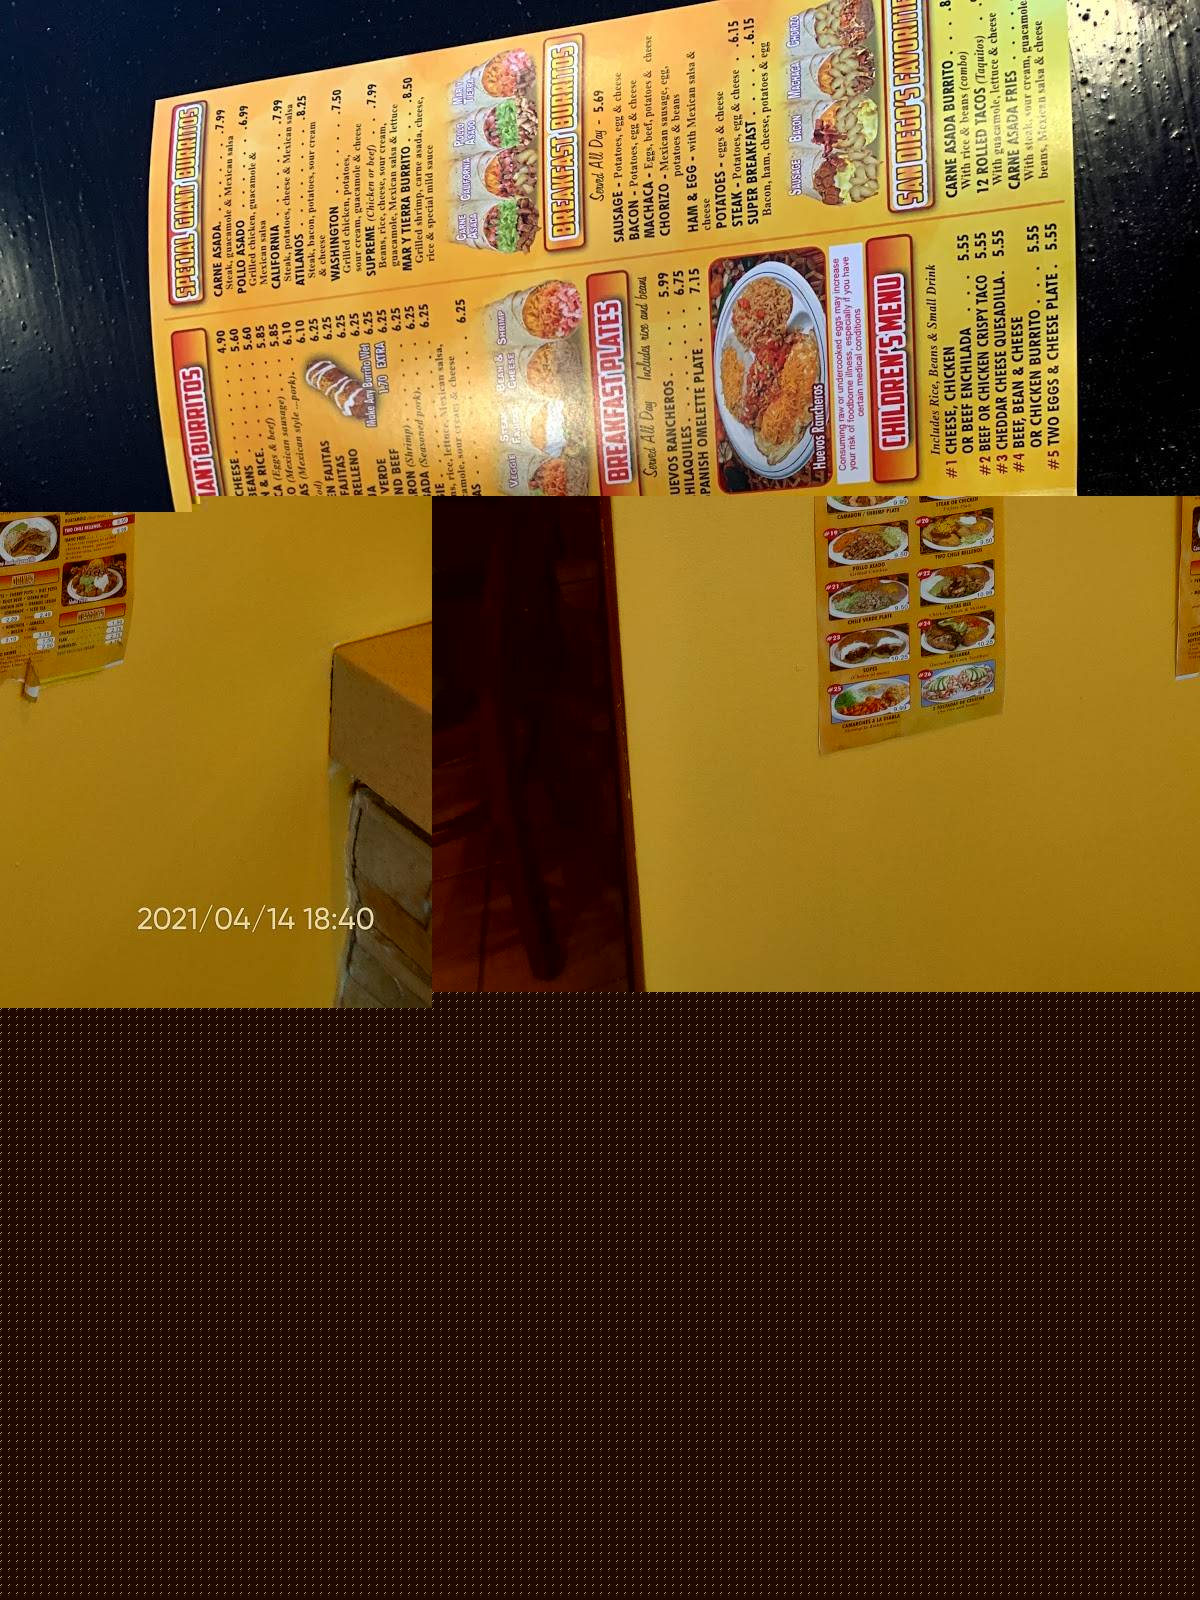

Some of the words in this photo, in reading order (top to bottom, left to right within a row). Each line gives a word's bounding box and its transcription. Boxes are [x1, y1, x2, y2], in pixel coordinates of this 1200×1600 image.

[549, 46, 575, 131] BURRITOS
[593, 90, 604, 113] 5.69
[942, 60, 955, 111] BURRITO
[974, 87, 987, 125] TACOS
[588, 130, 606, 148] Day
[894, 87, 923, 163] DIEGO'S
[944, 114, 956, 153] ASADA
[175, 107, 198, 180] BURRITOS
[588, 152, 603, 169] All
[745, 121, 757, 183] BREAKFAST
[976, 129, 988, 174] ROLLED
[224, 159, 233, 195] Mexican
[401, 146, 411, 192] BURRITO
[687, 165, 697, 188] EGG
[896, 164, 924, 206] SAN
[945, 158, 957, 198] CARNE
[977, 178, 988, 193] 12
[549, 136, 576, 238] BREAKFAST
[590, 173, 604, 202] Served
[688, 193, 698, 201] &
[715, 171, 727, 229] POTATOES
[174, 185, 195, 230] GIANT
[401, 196, 412, 234] TIERRA
[612, 191, 624, 242] SAUSAGE
[628, 200, 640, 240] BACON
[643, 181, 655, 238] MACHACA
[658, 183, 670, 236] CHORIZO
[688, 205, 699, 232] HAM
[732, 192, 743, 227] STEAK
[747, 187, 759, 225] SUPER
[224, 210, 234, 258] guacamole
[236, 220, 245, 255] ASADO
[329, 206, 340, 281] WASHINGTON
[402, 236, 411, 244] Y
[957, 234, 969, 261] 5.55
[975, 232, 987, 259] 5.55
[992, 230, 1004, 257] 5.55
[1045, 223, 1057, 250] 5.55
[174, 233, 196, 298] SPECIAL
[270, 225, 281, 289] CALIFORNIA
[294, 234, 305, 286] ATILANOS
[402, 247, 412, 271] MAR
[842, 256, 850, 277] have
[213, 263, 222, 297] CARNE
[225, 260, 234, 289] Steak,
[236, 260, 246, 293] POLLO
[658, 272, 669, 297] 5.99
[689, 268, 701, 294] 7.15
[832, 258, 840, 293] increase
[925, 264, 936, 295] Drink
[976, 275, 987, 304] TACO
[1046, 273, 1058, 309] PLATE
[377, 309, 388, 333] 6.25
[455, 299, 466, 323] 6.25
[833, 295, 843, 314] may
[876, 276, 904, 333] MENU
[927, 299, 937, 329] Small
[993, 276, 1006, 347] QUESADILLA
[242, 327, 252, 350] 5.60
[322, 317, 332, 340] 6.25
[349, 313, 360, 336] 6.25
[595, 301, 623, 372] PLATES
[834, 316, 844, 336] eggs
[843, 305, 853, 346] especially
[853, 308, 862, 351] conditions
[928, 332, 938, 341] &
[976, 308, 988, 347] CRISPY
[1046, 314, 1058, 360] CHEESE
[216, 330, 226, 354] 4.90
[359, 343, 371, 359] Wet
[375, 342, 387, 368] EXTRA
[361, 361, 373, 387] Burrito
[691, 348, 705, 384] PLATE
[834, 338, 844, 394] undercooked
[844, 349, 854, 378] illness,
[854, 354, 863, 386] medical
[928, 345, 939, 377] Beans
[943, 346, 956, 401] CHICKEN
[960, 327, 972, 398] ENCHILADA
[977, 351, 989, 401] CHICKEN
[995, 350, 1006, 392] CHEESE
[1047, 365, 1058, 374] &
[364, 390, 376, 404] Any
[811, 384, 824, 433] Rancheros
[837, 396, 844, 404] or
[845, 380, 854, 423] foodborne
[855, 389, 864, 416] certain
[878, 335, 907, 448] CHILDREN'S
[929, 381, 940, 407] Rice,
[1047, 378, 1059, 412] EGGS
[182, 369, 209, 456] BURRITOS
[365, 406, 377, 427] Make
[599, 375, 630, 481] BREAKFAST
[662, 380, 678, 452] RANCHEROS
[692, 387, 708, 447] OMELETTE
[837, 407, 845, 421] raw
[847, 424, 854, 433] of
[961, 403, 973, 432] BEEF
[978, 405, 990, 421] OR
[996, 396, 1008, 450] CHEDDAR
[847, 434, 855, 450] risk
[930, 410, 941, 455] Includes
[945, 406, 958, 454] CHEESE,
[962, 436, 974, 454] OR
[979, 425, 990, 451] BEEF
[1047, 416, 1060, 446] TWO
[320, 440, 334, 481] FAJITAS
[812, 435, 826, 470] Huevos
[838, 424, 847, 471] Consuming
[849, 452, 857, 471] your
[997, 454, 1008, 474] #3
[1048, 450, 1060, 470] #5
[348, 448, 363, 496] RELLENO
[376, 459, 389, 494] VERDE
[946, 460, 957, 478] #1
[980, 455, 991, 476] #2
